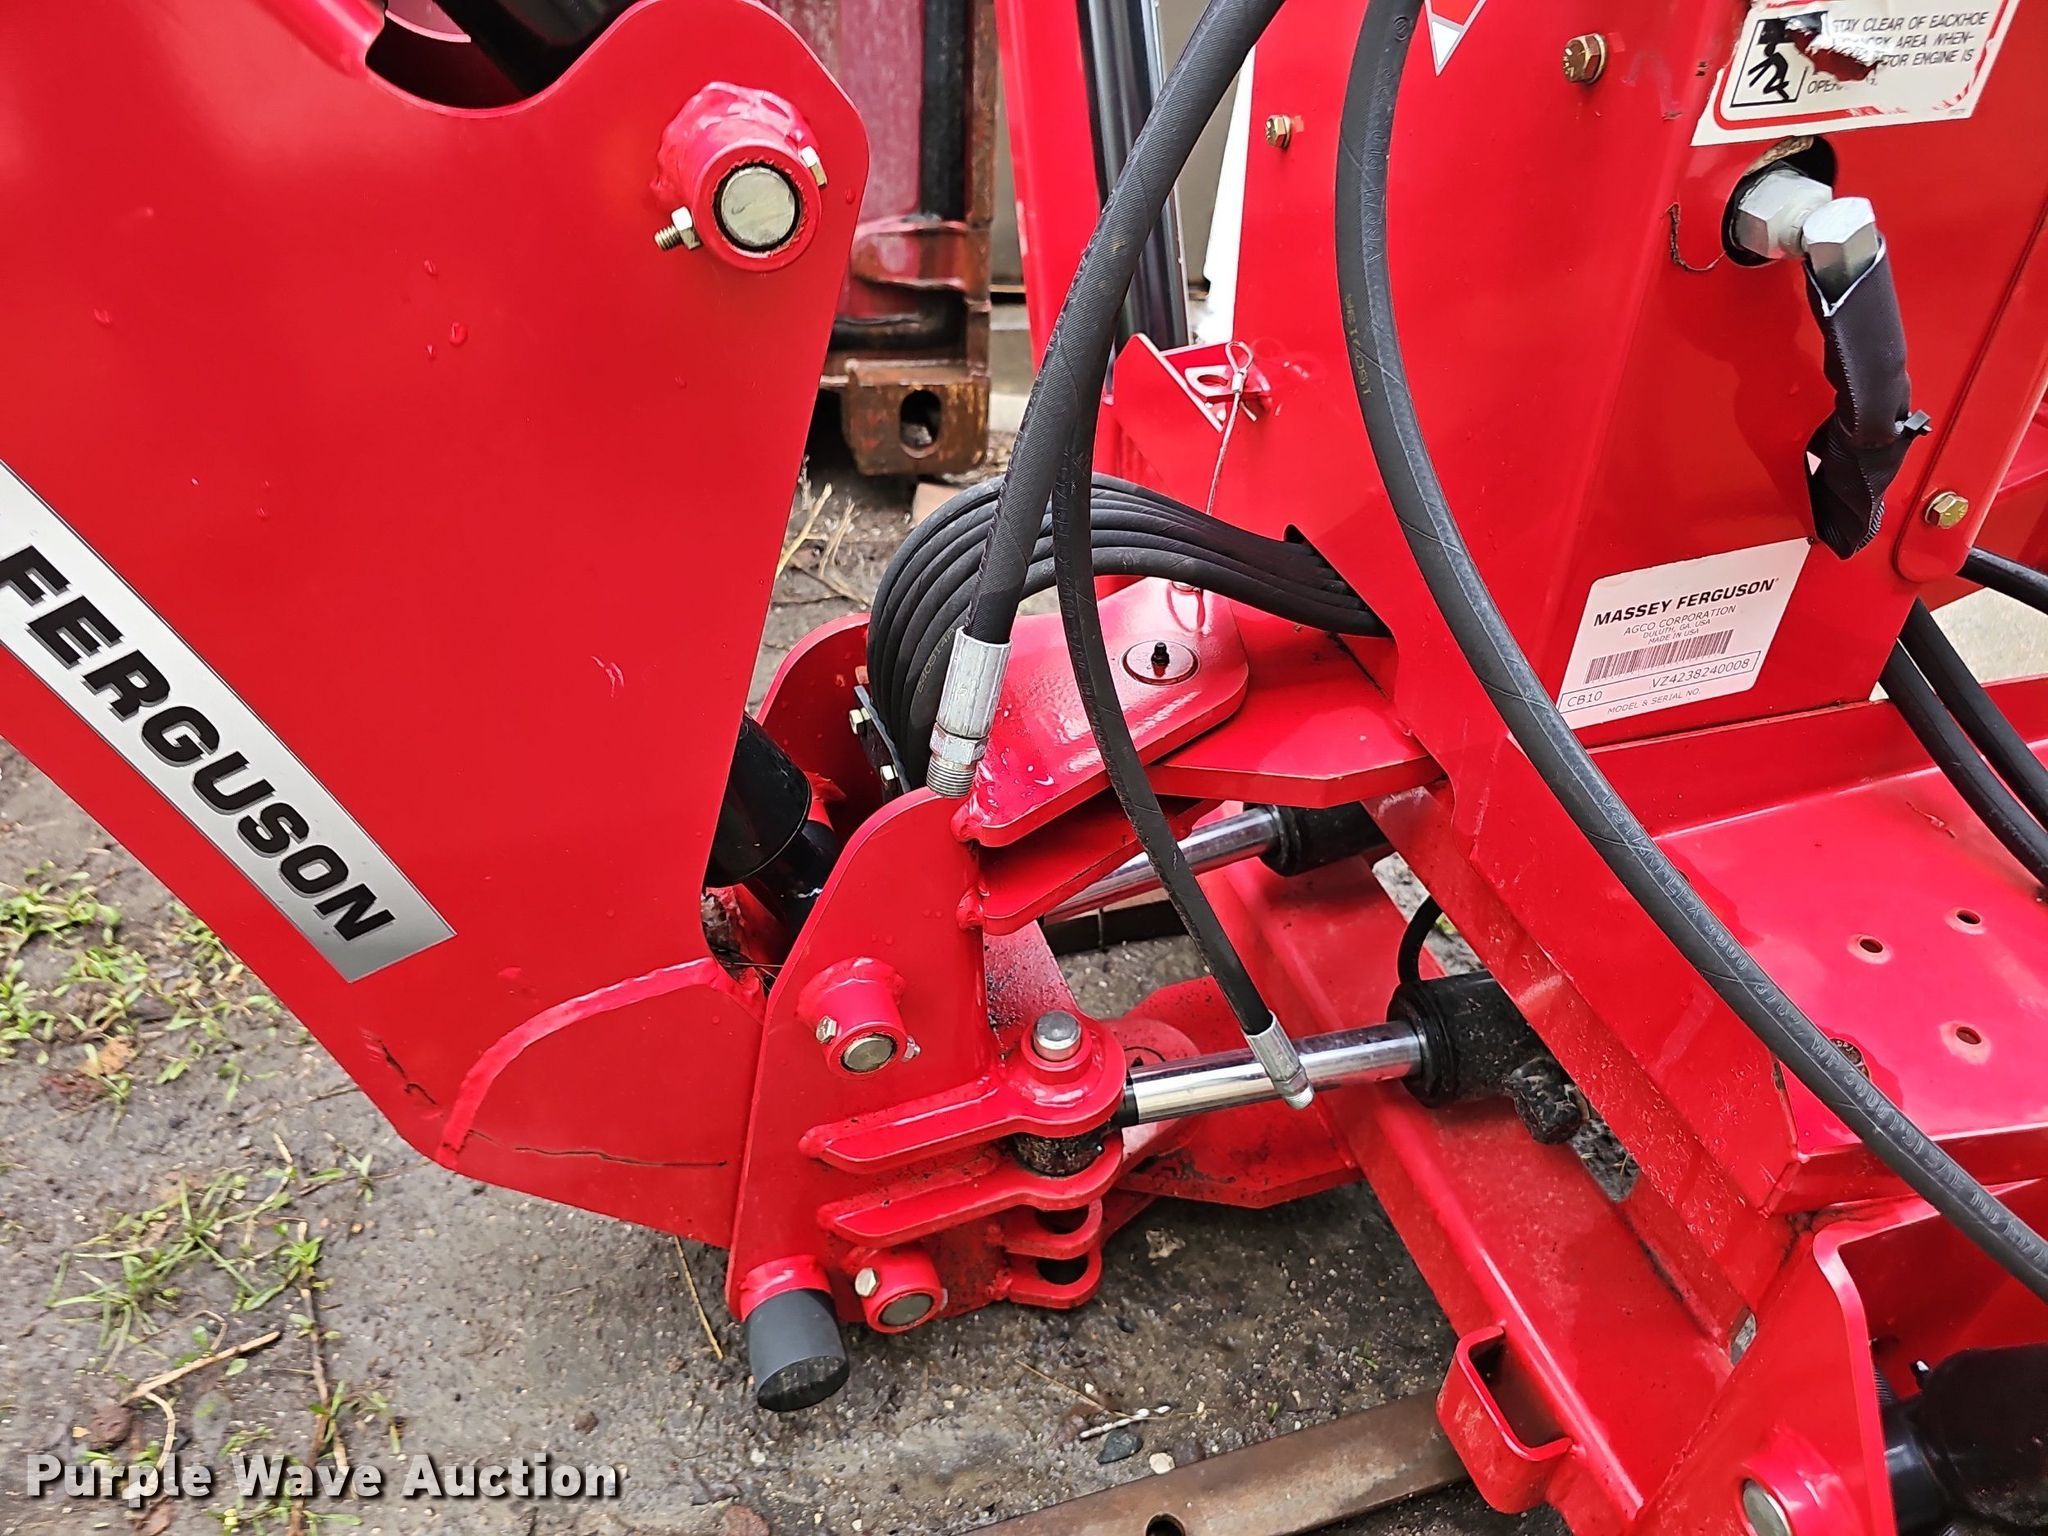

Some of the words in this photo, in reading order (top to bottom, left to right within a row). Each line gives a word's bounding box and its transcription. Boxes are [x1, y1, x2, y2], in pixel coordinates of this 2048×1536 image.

[1863, 17, 1905, 32] CLEAR
[1908, 15, 1926, 30] OF
[1961, 48, 1975, 62] IS
[1593, 599, 1672, 627] MASSEY
[1676, 578, 1776, 609] FERGUSON
[1624, 622, 1655, 636] AGCO
[1659, 605, 1736, 629] CORPORATION
[1694, 619, 1711, 629] USA
[1648, 634, 1671, 645] MADE
[1673, 632, 1682, 640] IN
[1683, 628, 1699, 638] USA
[1567, 691, 1603, 707] CB10
[1651, 658, 1750, 689] VZ4238240008
[1607, 702, 1639, 714] MODEL
[1650, 694, 1683, 706] SERIAL
[0, 544, 396, 942] FERGUSON
